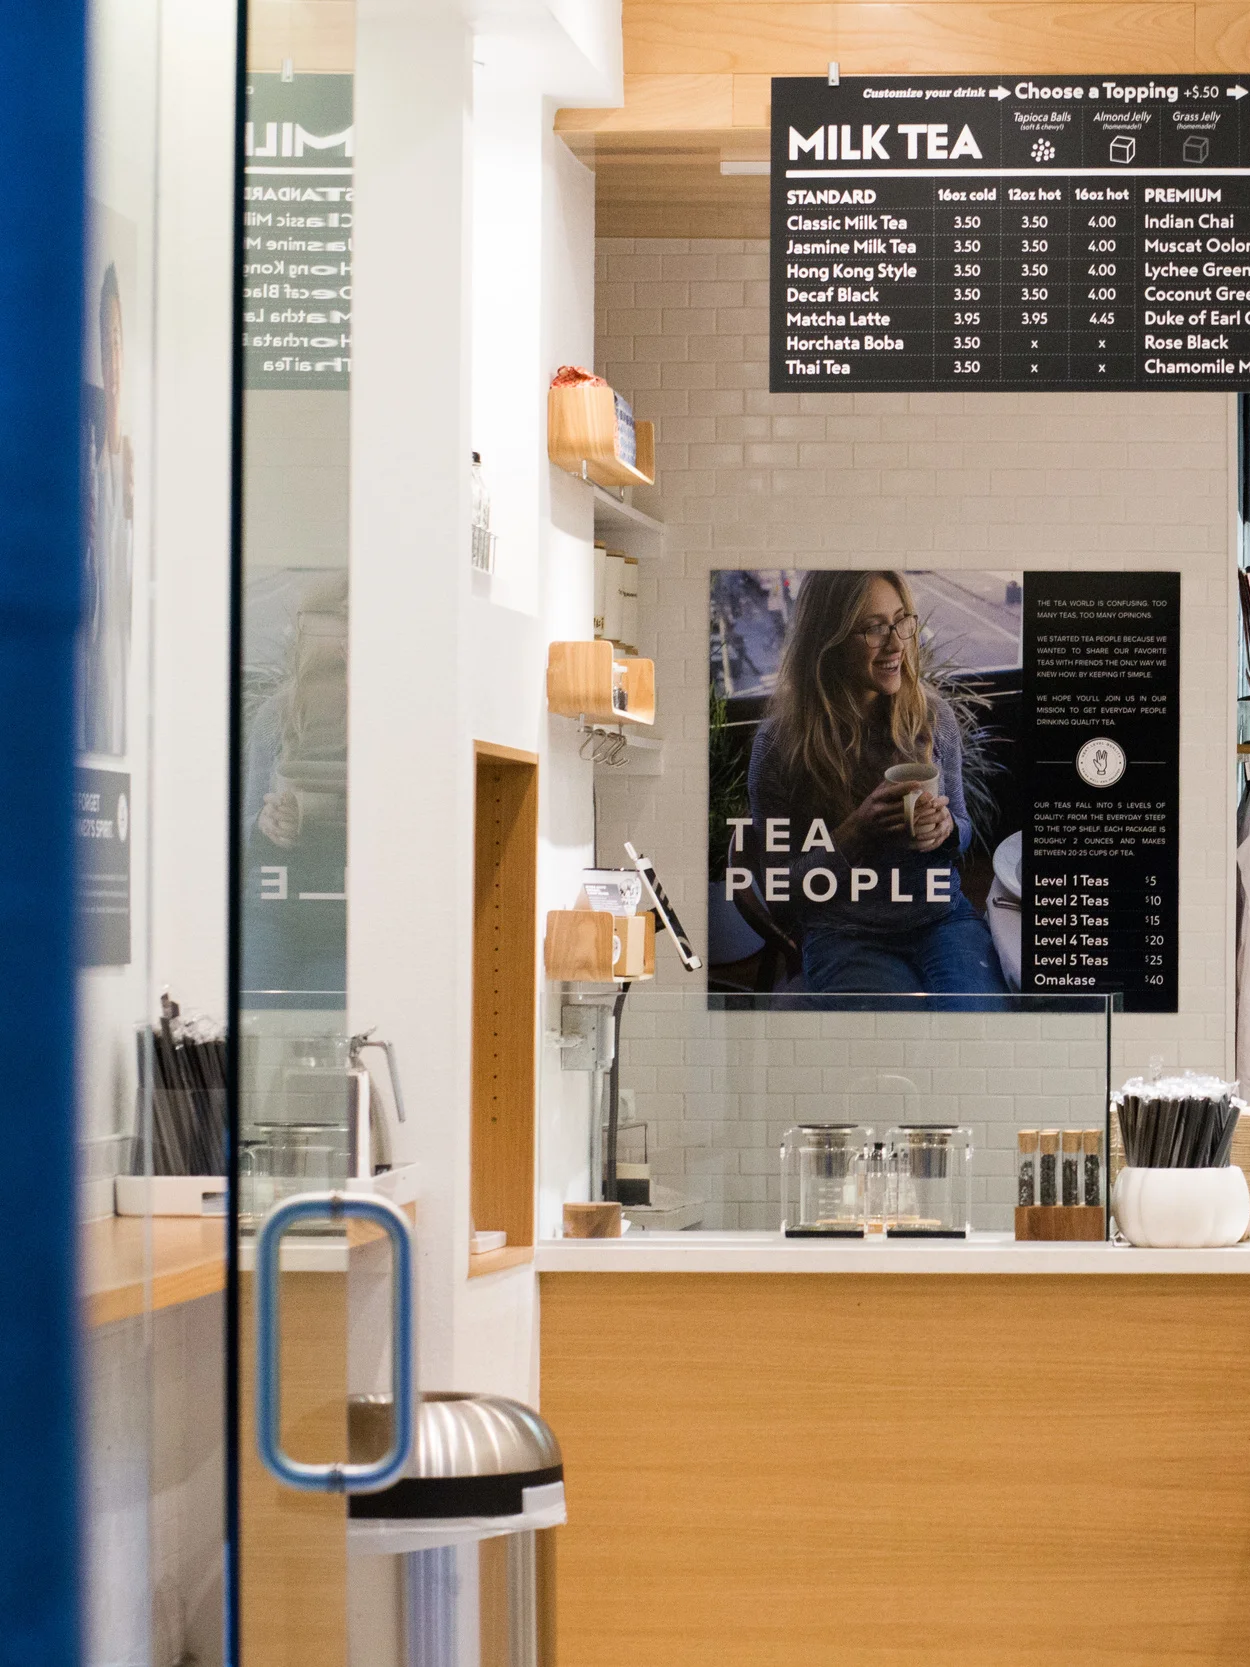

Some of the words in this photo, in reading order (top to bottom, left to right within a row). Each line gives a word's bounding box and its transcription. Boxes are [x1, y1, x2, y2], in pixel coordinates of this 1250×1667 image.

[863, 88, 923, 98] Customize
[925, 90, 952, 100] your
[954, 87, 986, 98] drink
[1015, 82, 1084, 99] Choose
[1089, 87, 1099, 99] a
[1102, 82, 1178, 103] Topping
[1184, 86, 1219, 99] +$.50
[1014, 112, 1049, 123] Tapioca
[1050, 112, 1071, 122] Balls
[1093, 112, 1130, 122] Almond
[1131, 112, 1152, 123] Jelly
[789, 124, 890, 161] MILK
[898, 124, 983, 160] TEA
[787, 189, 877, 205] STANDARD
[938, 189, 967, 201] 16oz
[969, 188, 997, 201] cold
[1008, 188, 1036, 201] 12oz
[1038, 188, 1062, 200] hot
[1075, 188, 1104, 200] 16oz
[1107, 188, 1129, 200] hot
[1145, 188, 1221, 203] PREMIUM
[787, 215, 841, 231] Classic
[845, 215, 878, 230] Milk
[880, 215, 907, 230] Tea
[954, 216, 981, 229] 3.50
[1022, 216, 1048, 228] 3.50
[1088, 216, 1116, 228] 4.00
[1145, 239, 1202, 253] Muscat
[787, 311, 846, 327] Matcha
[850, 312, 891, 326] Latte
[954, 312, 980, 325] 3.95
[1022, 312, 1048, 325] 3.95
[1090, 312, 1115, 325] 4.45
[1145, 310, 1184, 325] Duke
[1188, 310, 1207, 325] of
[1211, 310, 1240, 325] Earl
[727, 819, 835, 852] TEA
[726, 868, 950, 902] PEOPLE
[1036, 875, 1066, 886] Level
[1074, 875, 1077, 886] 1
[1080, 875, 1109, 886] Teas
[1146, 876, 1156, 886] $5
[1035, 954, 1066, 965] Level
[1070, 954, 1077, 965] 5
[1080, 955, 1108, 966] Teas
[1146, 956, 1162, 965] $25
[1035, 974, 1096, 985] Omakase
[1146, 975, 1163, 985] $40
